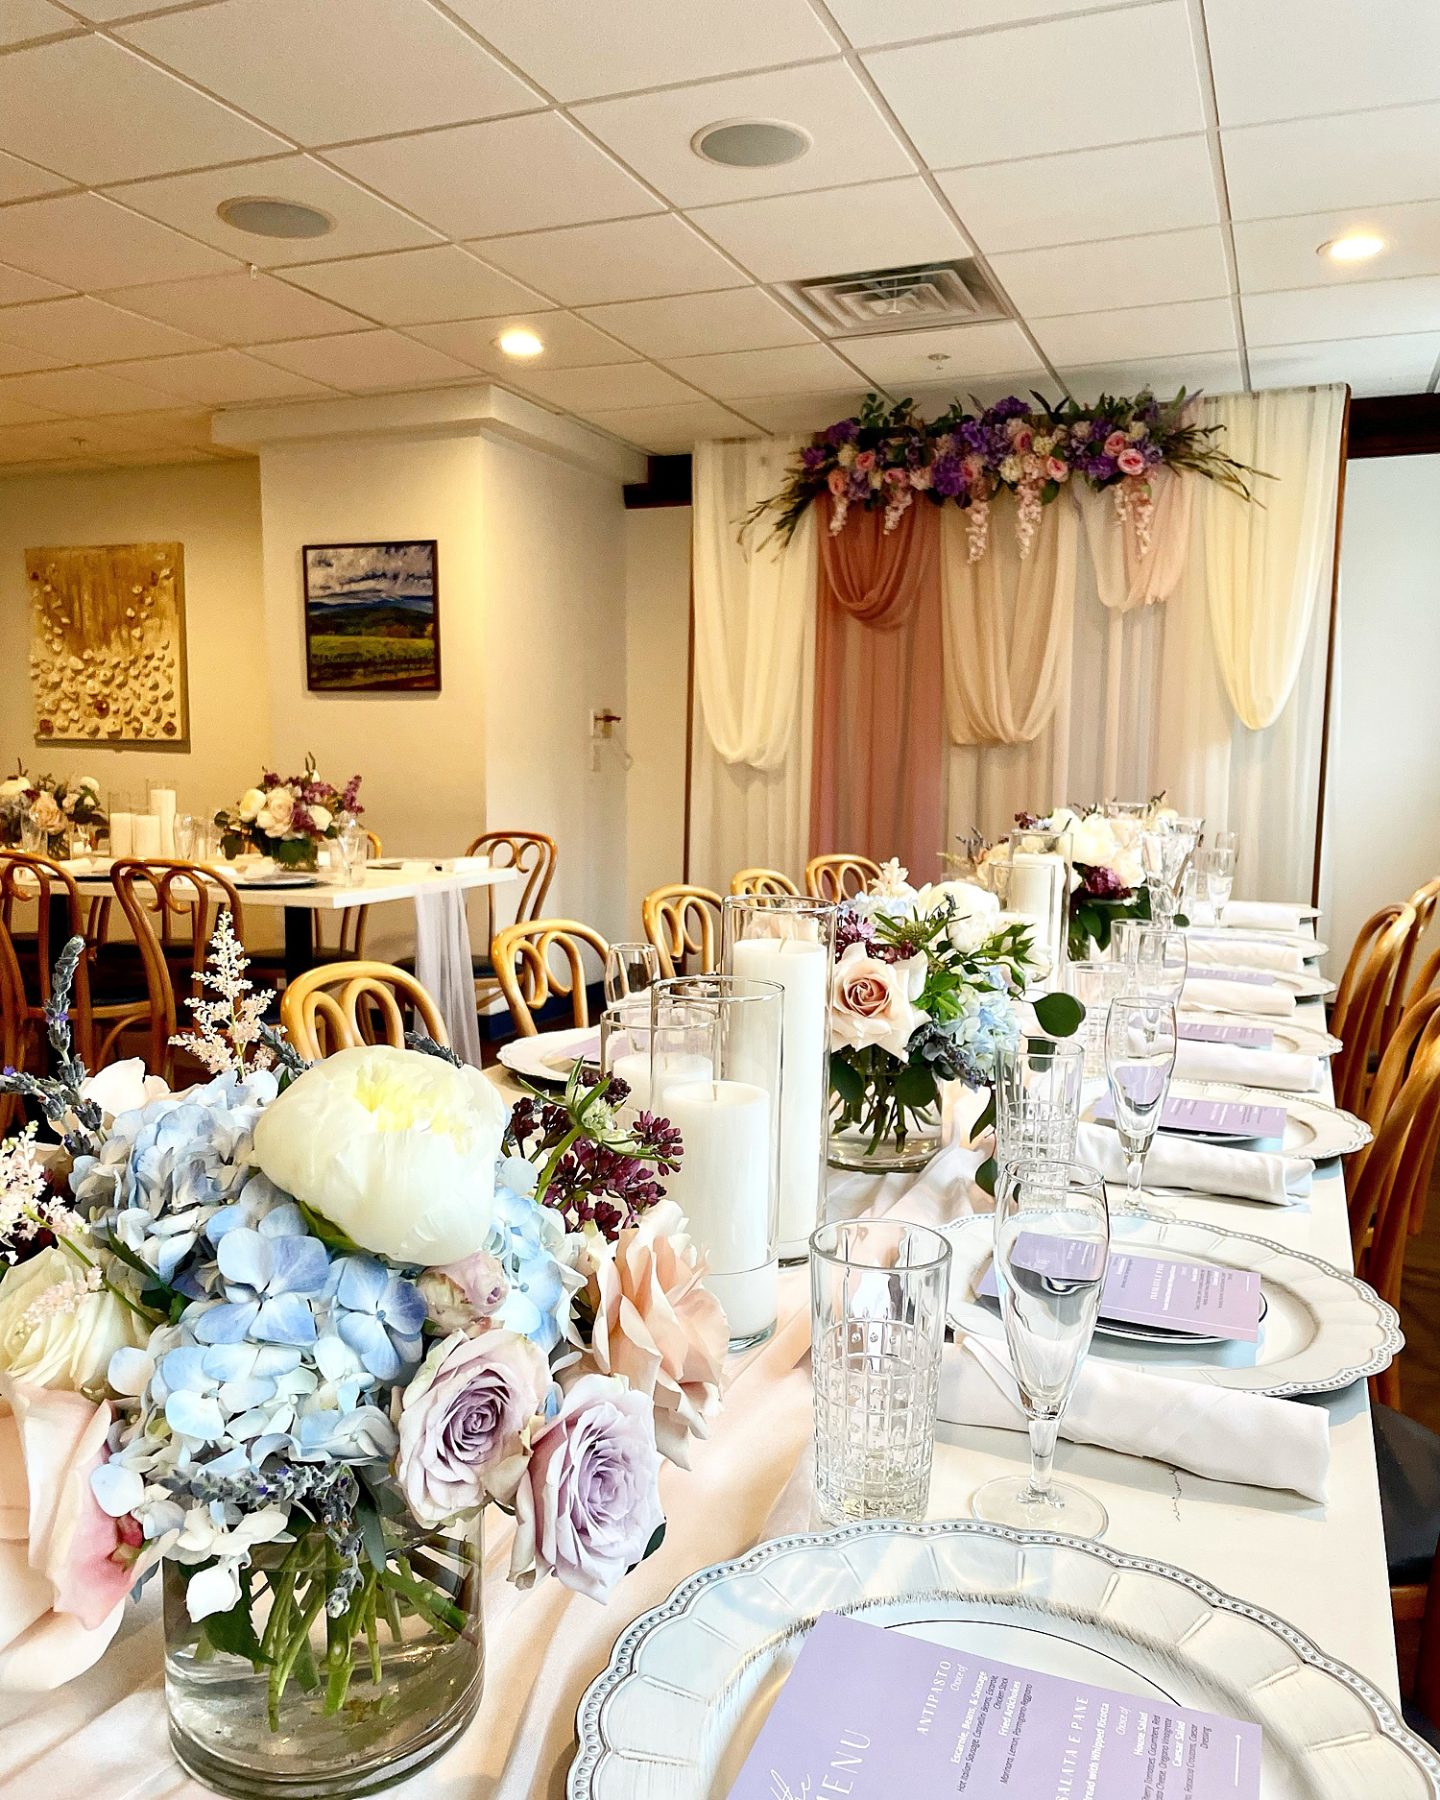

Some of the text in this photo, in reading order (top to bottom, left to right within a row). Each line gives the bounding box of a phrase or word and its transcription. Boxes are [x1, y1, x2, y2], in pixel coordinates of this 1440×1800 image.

[917, 1661, 951, 1736] ANTIPASTO
[971, 1671, 988, 1698] Sausage
[993, 1678, 1008, 1710] Chicken Stock
[998, 1681, 1020, 1736] Fried Artichokes
[1071, 1696, 1088, 1730] PANE
[1097, 1703, 1110, 1729] Ricotta
[1069, 1735, 1081, 1743] E
[1090, 1728, 1105, 1760] Whipped
[1133, 1712, 1148, 1756] House Salad
[1172, 1720, 1186, 1767] Caesar Salad
[816, 1729, 871, 1800] ENU
[960, 1762, 971, 1781] Italian
[1088, 1761, 1099, 1780] with
[957, 1780, 967, 1792] Hot
